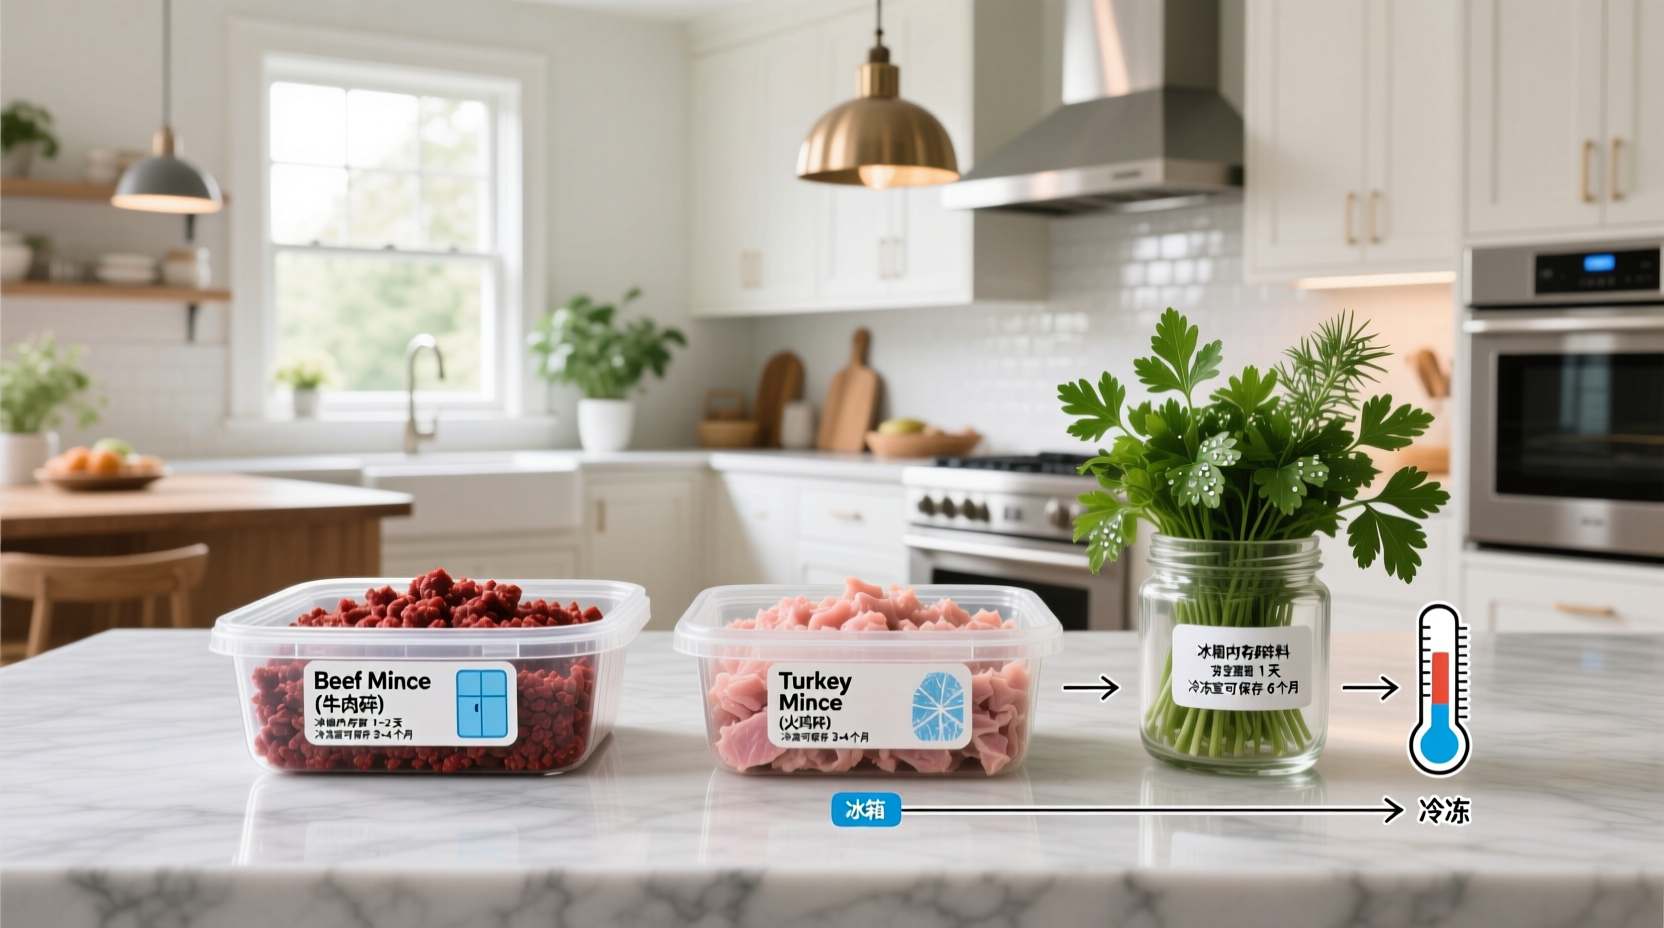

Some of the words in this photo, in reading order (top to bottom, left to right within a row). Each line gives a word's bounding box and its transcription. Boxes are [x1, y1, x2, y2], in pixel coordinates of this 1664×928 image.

[314, 670, 363, 690] Beef
[368, 670, 431, 690] Mince
[778, 671, 852, 696] Turkey
[779, 692, 843, 711] Mince
